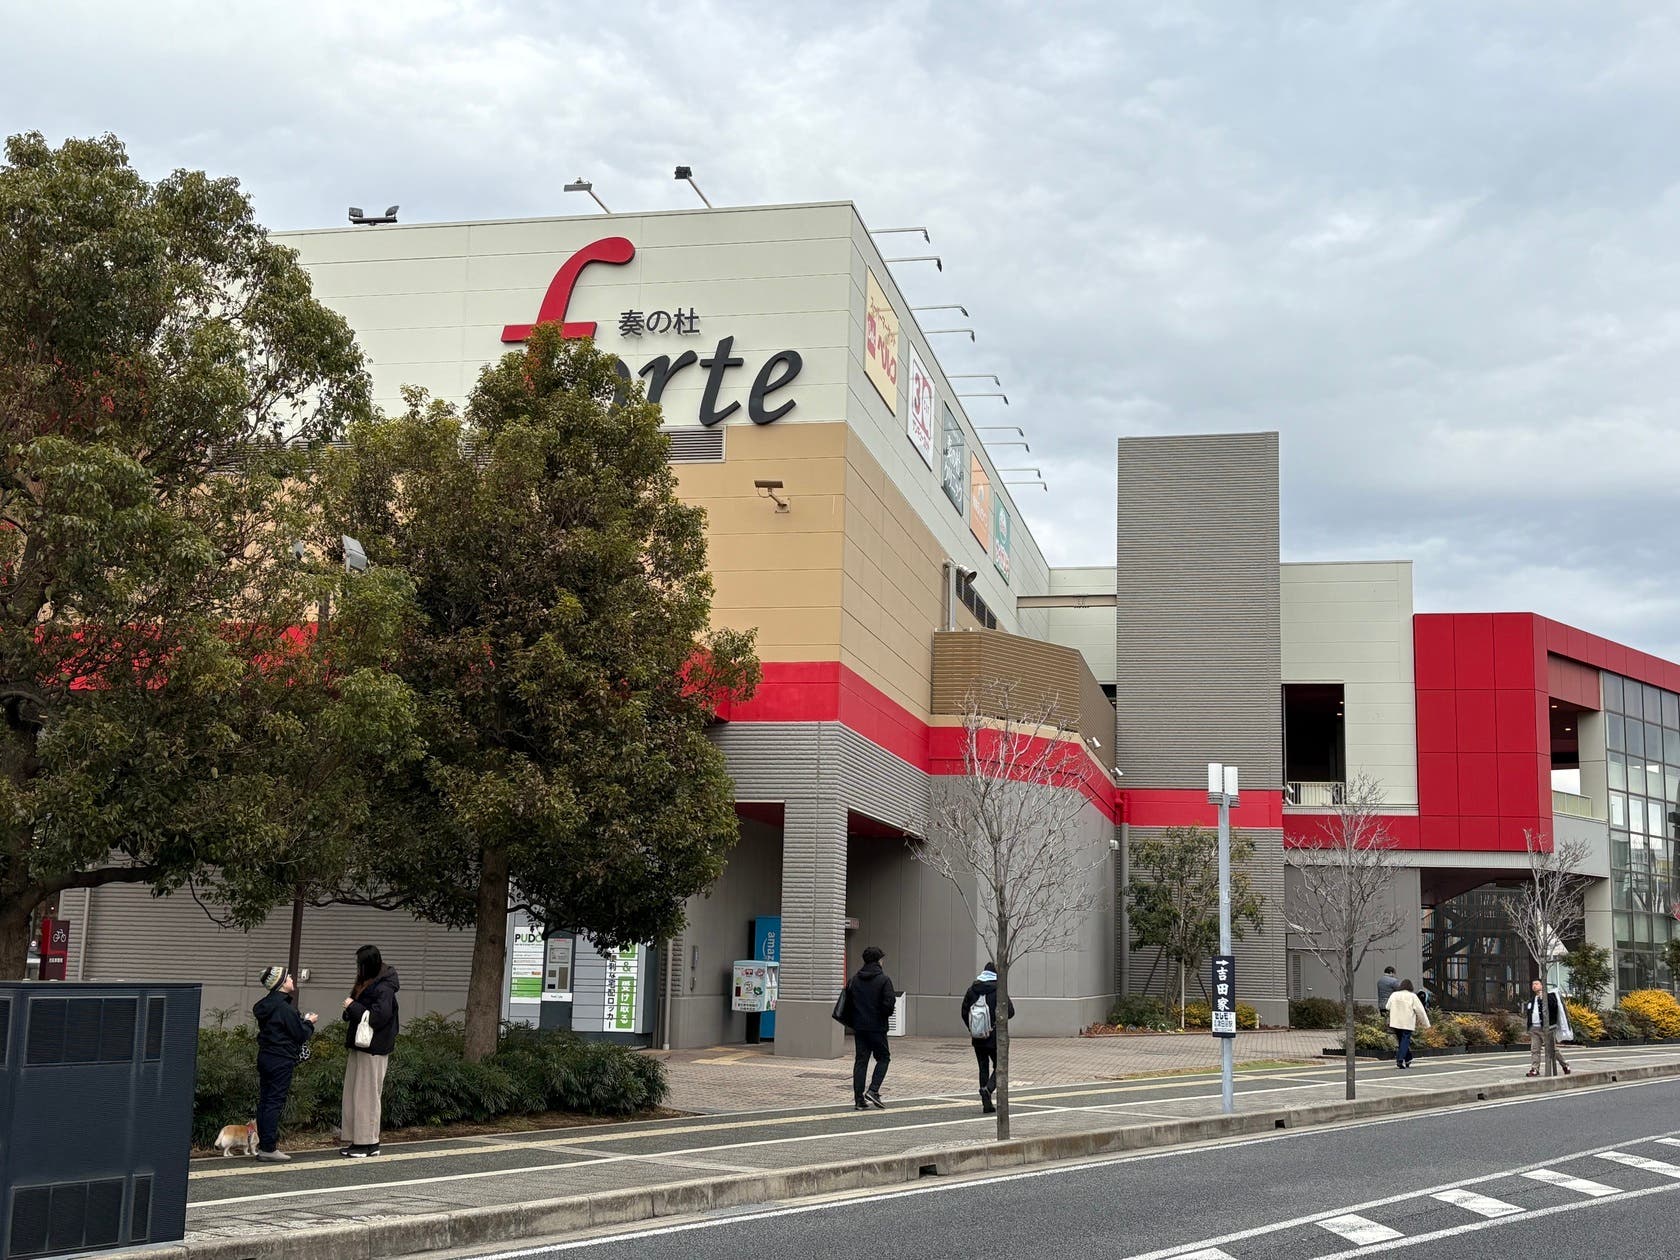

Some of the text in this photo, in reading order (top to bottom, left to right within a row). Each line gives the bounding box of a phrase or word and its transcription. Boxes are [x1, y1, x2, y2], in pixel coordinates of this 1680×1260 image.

[501, 236, 803, 427] frte
[618, 307, 699, 337] 奏の杜
[767, 931, 776, 961] amaz
[620, 980, 631, 1025] 受け取る
[1216, 966, 1230, 1012] 吉田家
